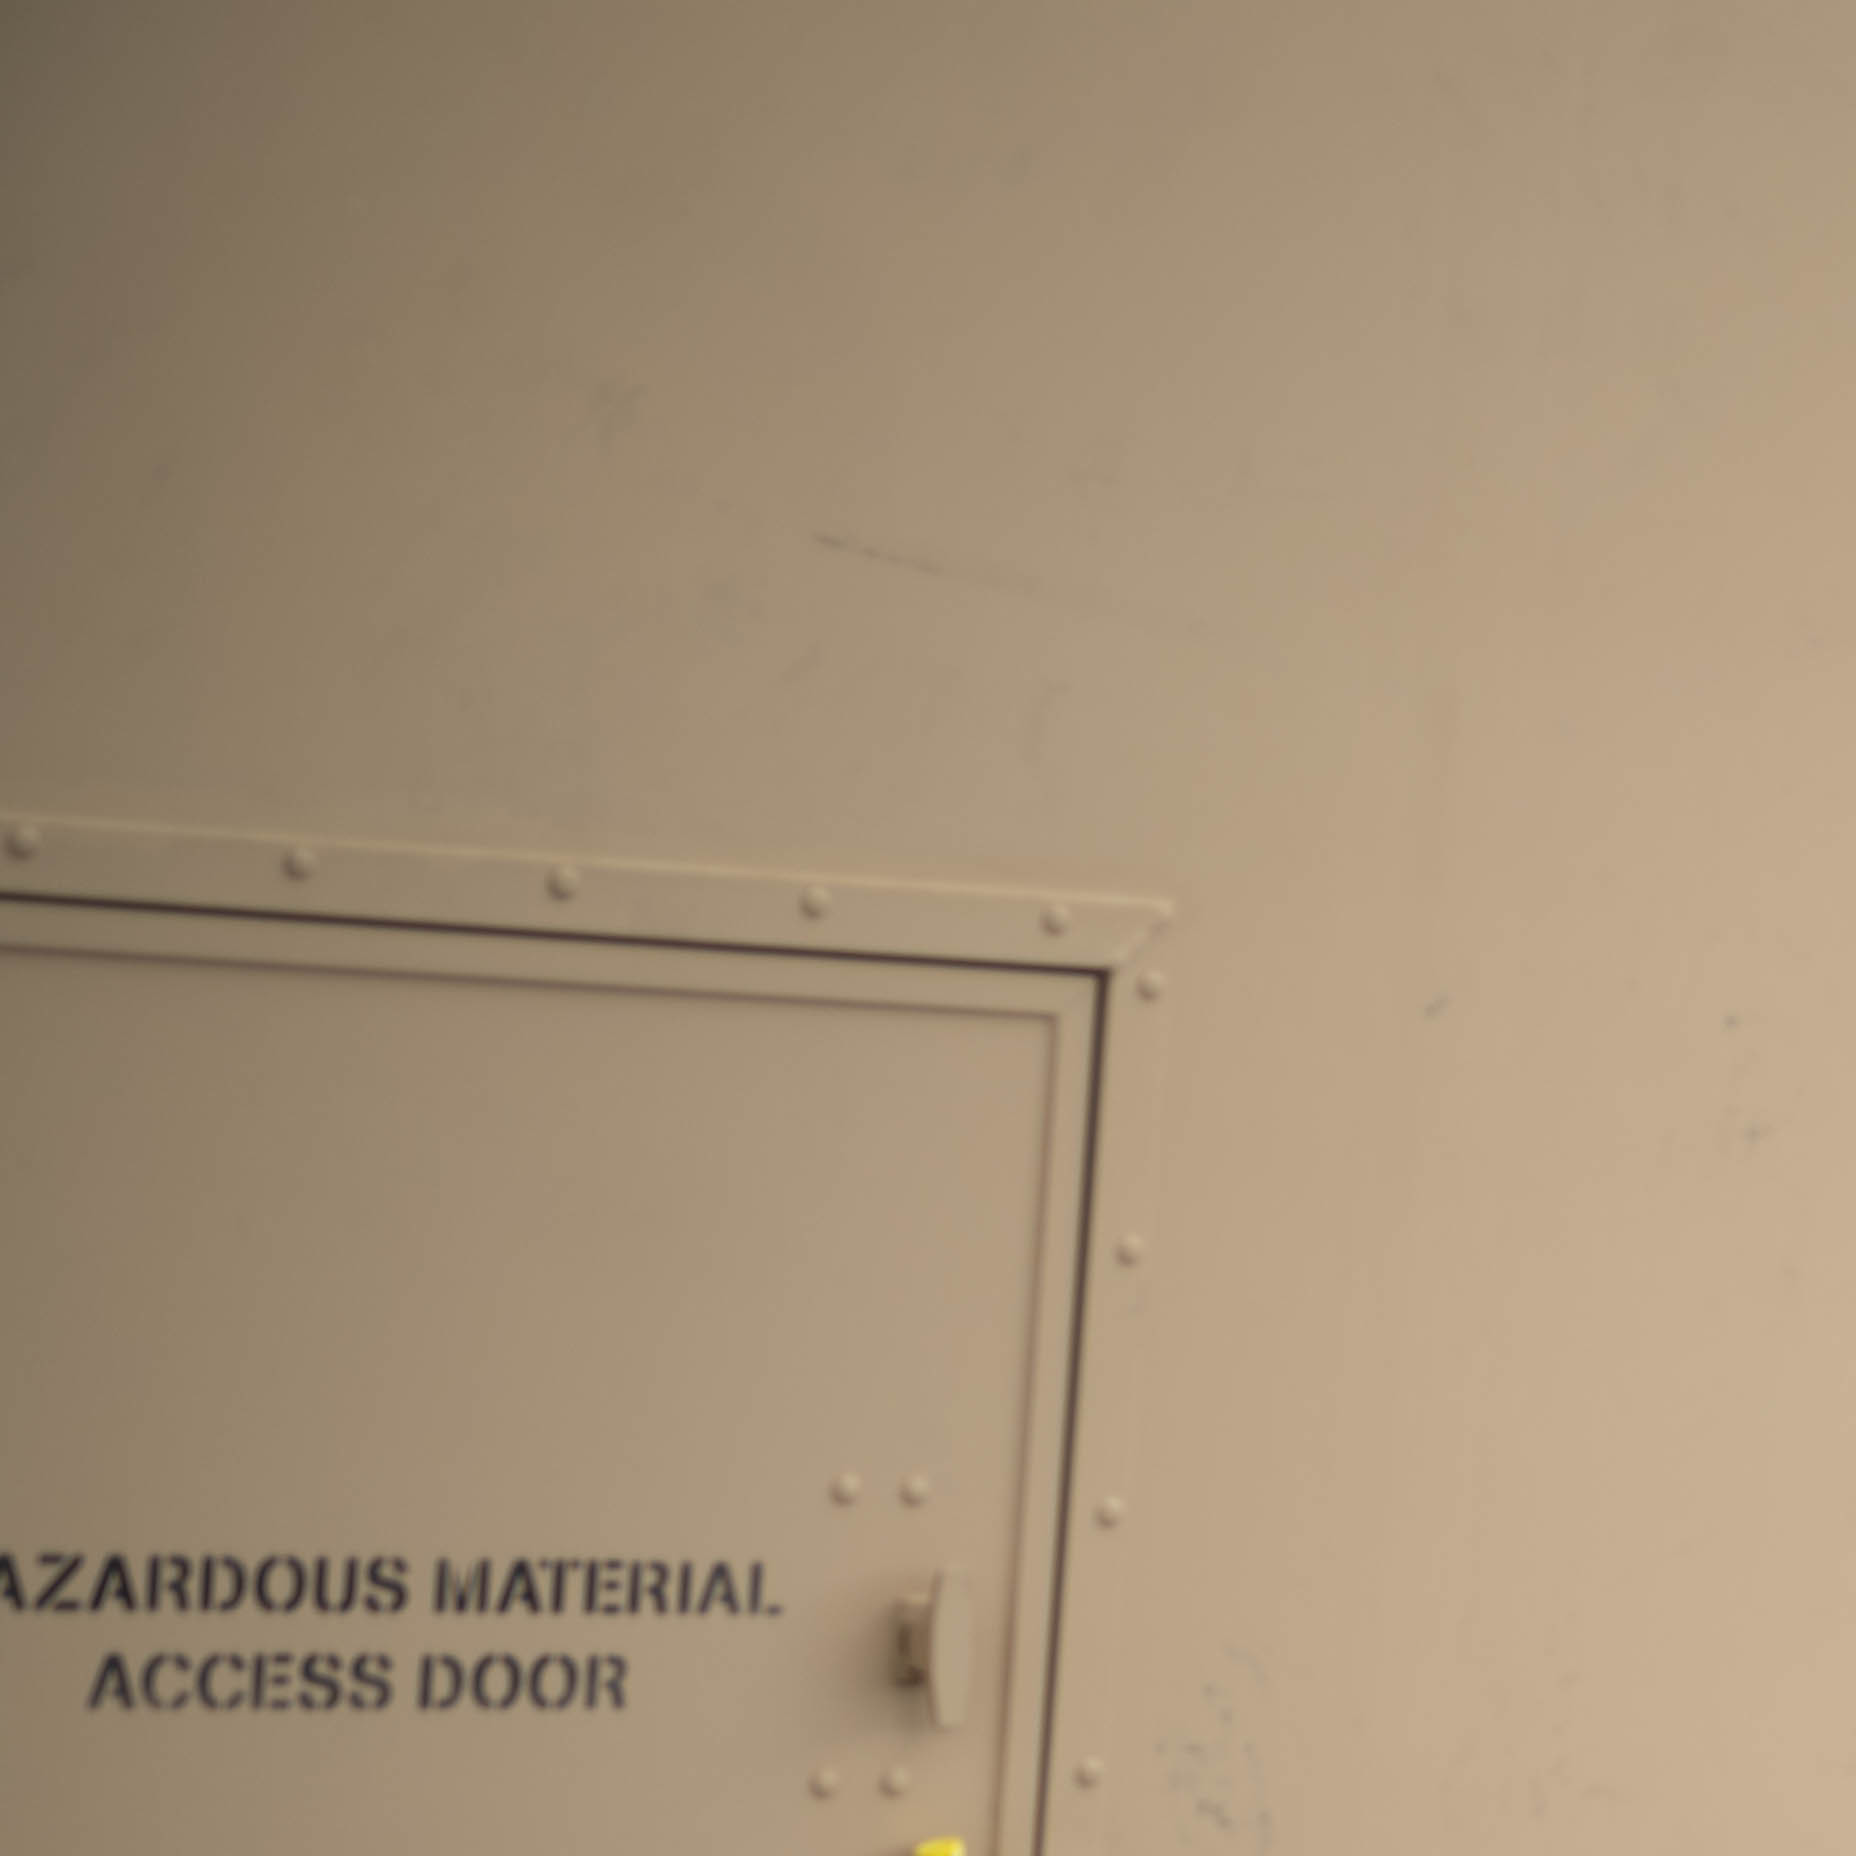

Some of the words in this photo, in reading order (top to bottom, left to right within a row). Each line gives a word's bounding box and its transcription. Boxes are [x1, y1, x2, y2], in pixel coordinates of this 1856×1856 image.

[0, 1550, 409, 1616] AZARDOUS
[431, 1556, 784, 1617] MATERIAL
[85, 1651, 394, 1712] ACCESS
[416, 1651, 629, 1712] DOOR
